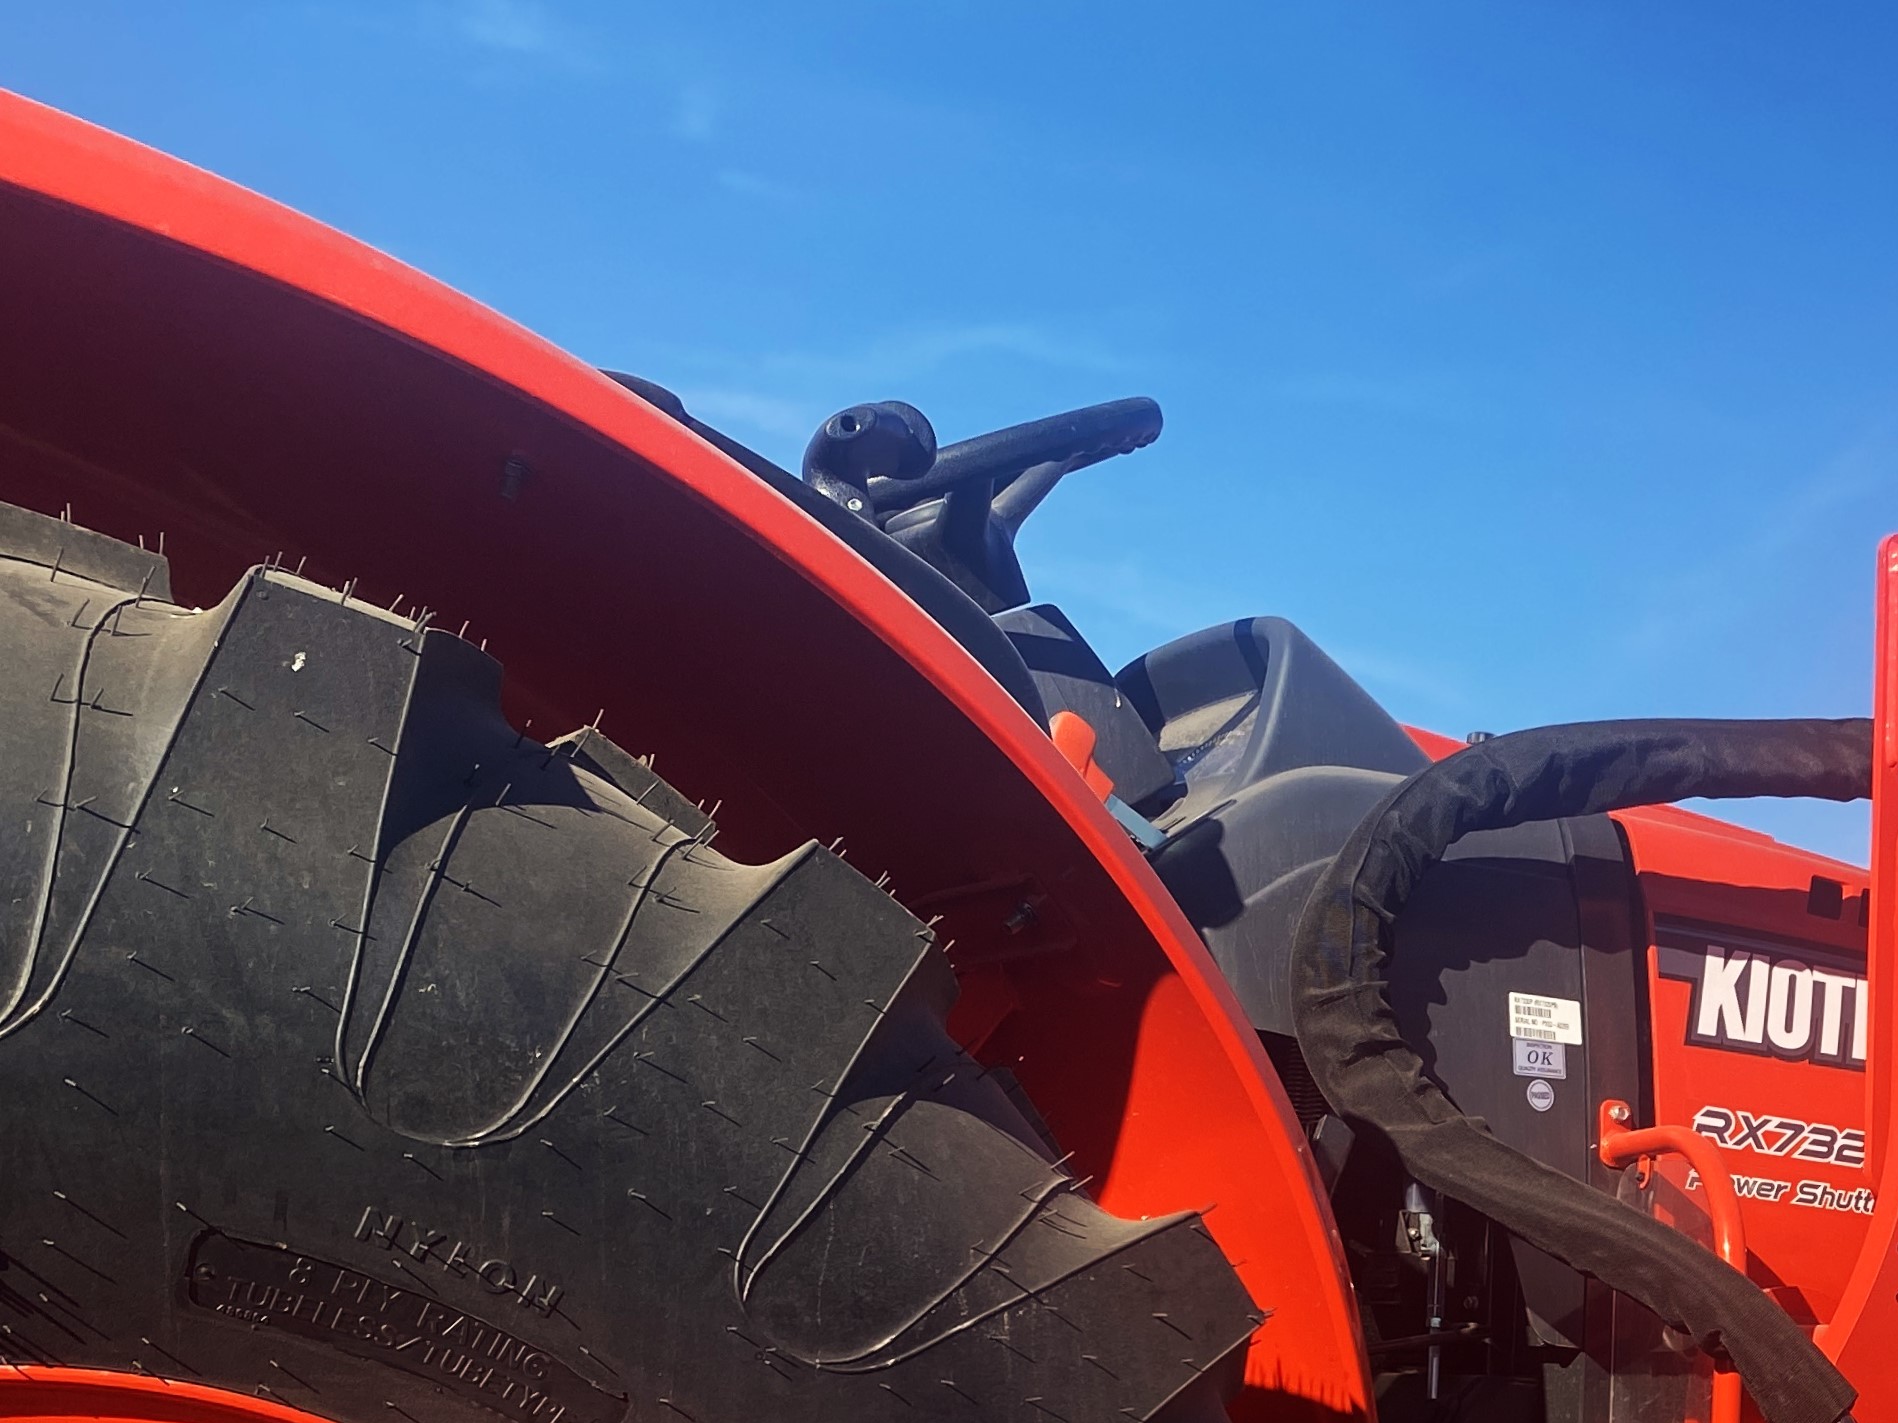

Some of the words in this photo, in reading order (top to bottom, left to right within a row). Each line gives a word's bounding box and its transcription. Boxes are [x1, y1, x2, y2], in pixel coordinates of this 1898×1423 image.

[1527, 1050, 1553, 1066] OK
[287, 1256, 317, 1288] 8
[330, 1269, 401, 1313] PLY
[416, 1301, 552, 1380] RATING
[353, 1205, 565, 1319] NYLON
